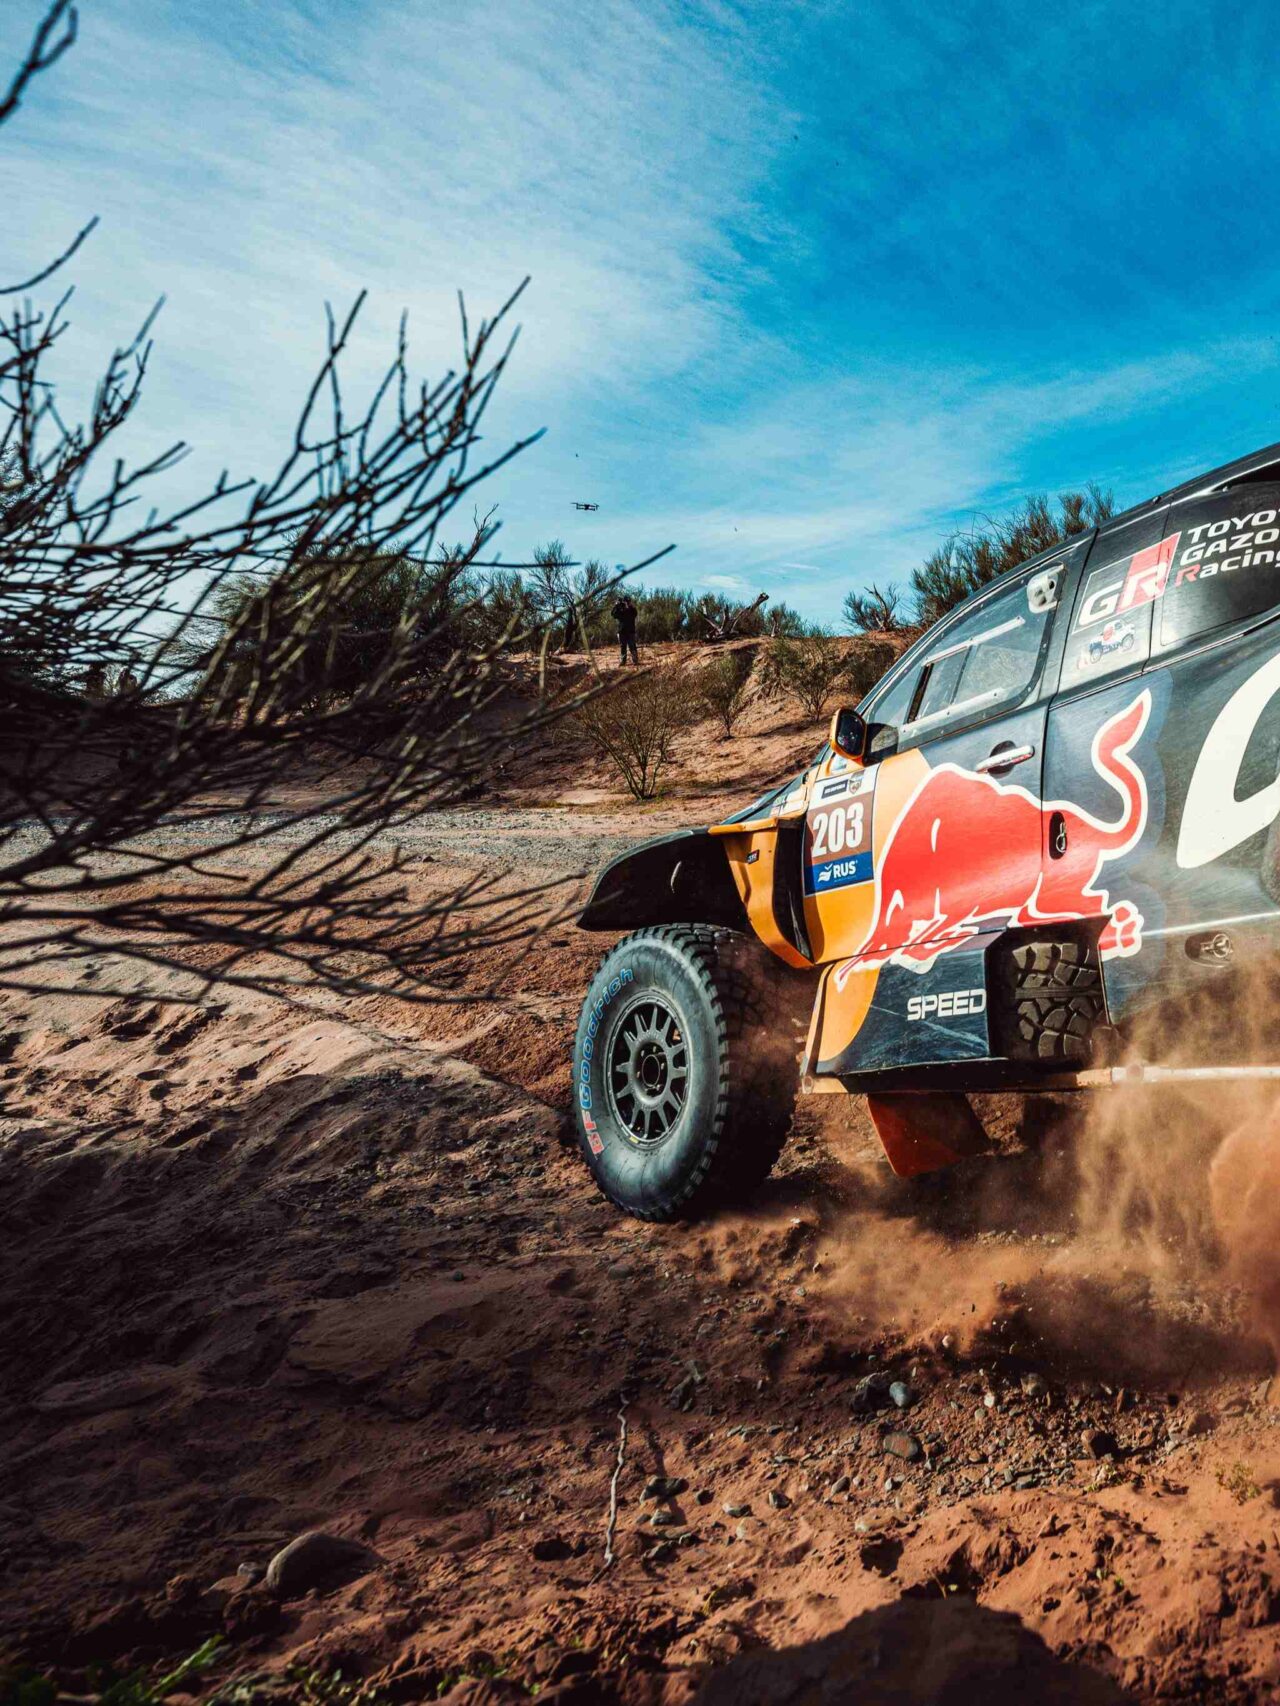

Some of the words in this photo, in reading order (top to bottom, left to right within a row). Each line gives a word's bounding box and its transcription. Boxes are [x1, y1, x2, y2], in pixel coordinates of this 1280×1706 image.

[1077, 560, 1168, 626] GR
[811, 802, 864, 858] 203
[833, 860, 856, 878] RUS
[907, 988, 987, 1021] SPEED
